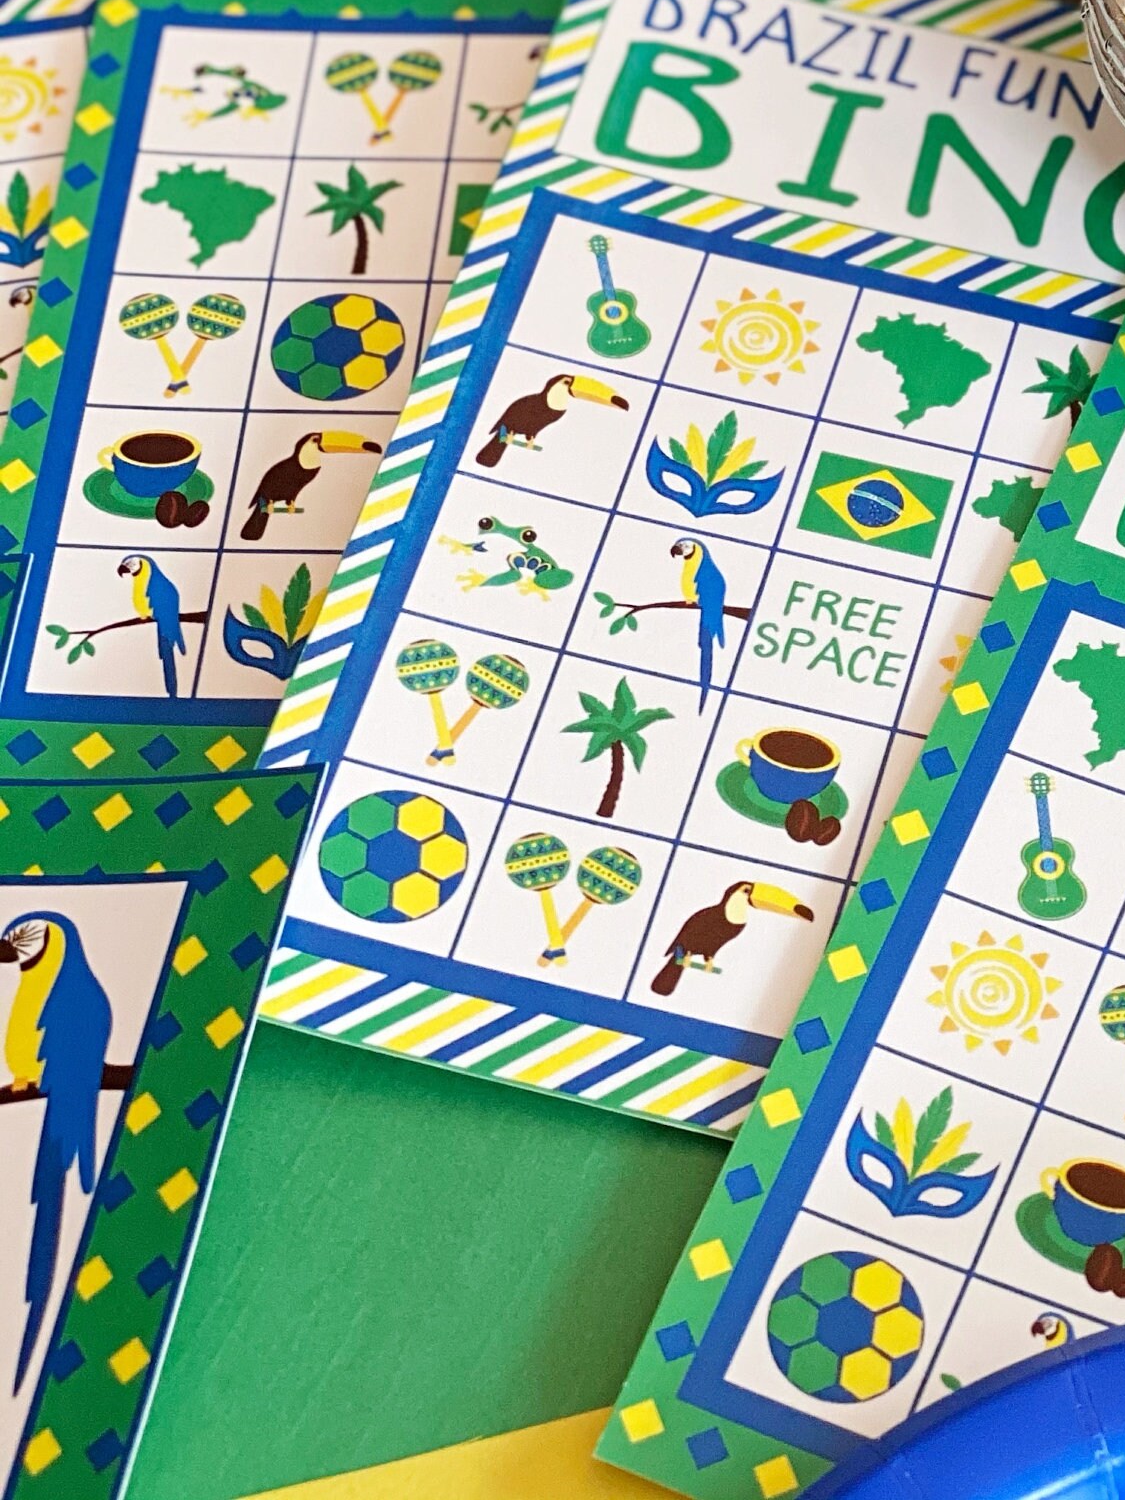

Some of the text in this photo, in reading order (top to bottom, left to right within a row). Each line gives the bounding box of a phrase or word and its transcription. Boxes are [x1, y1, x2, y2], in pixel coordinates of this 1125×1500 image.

[948, 44, 1104, 132] FUN
[783, 580, 904, 640] FREE
[753, 622, 908, 688] SPACE
